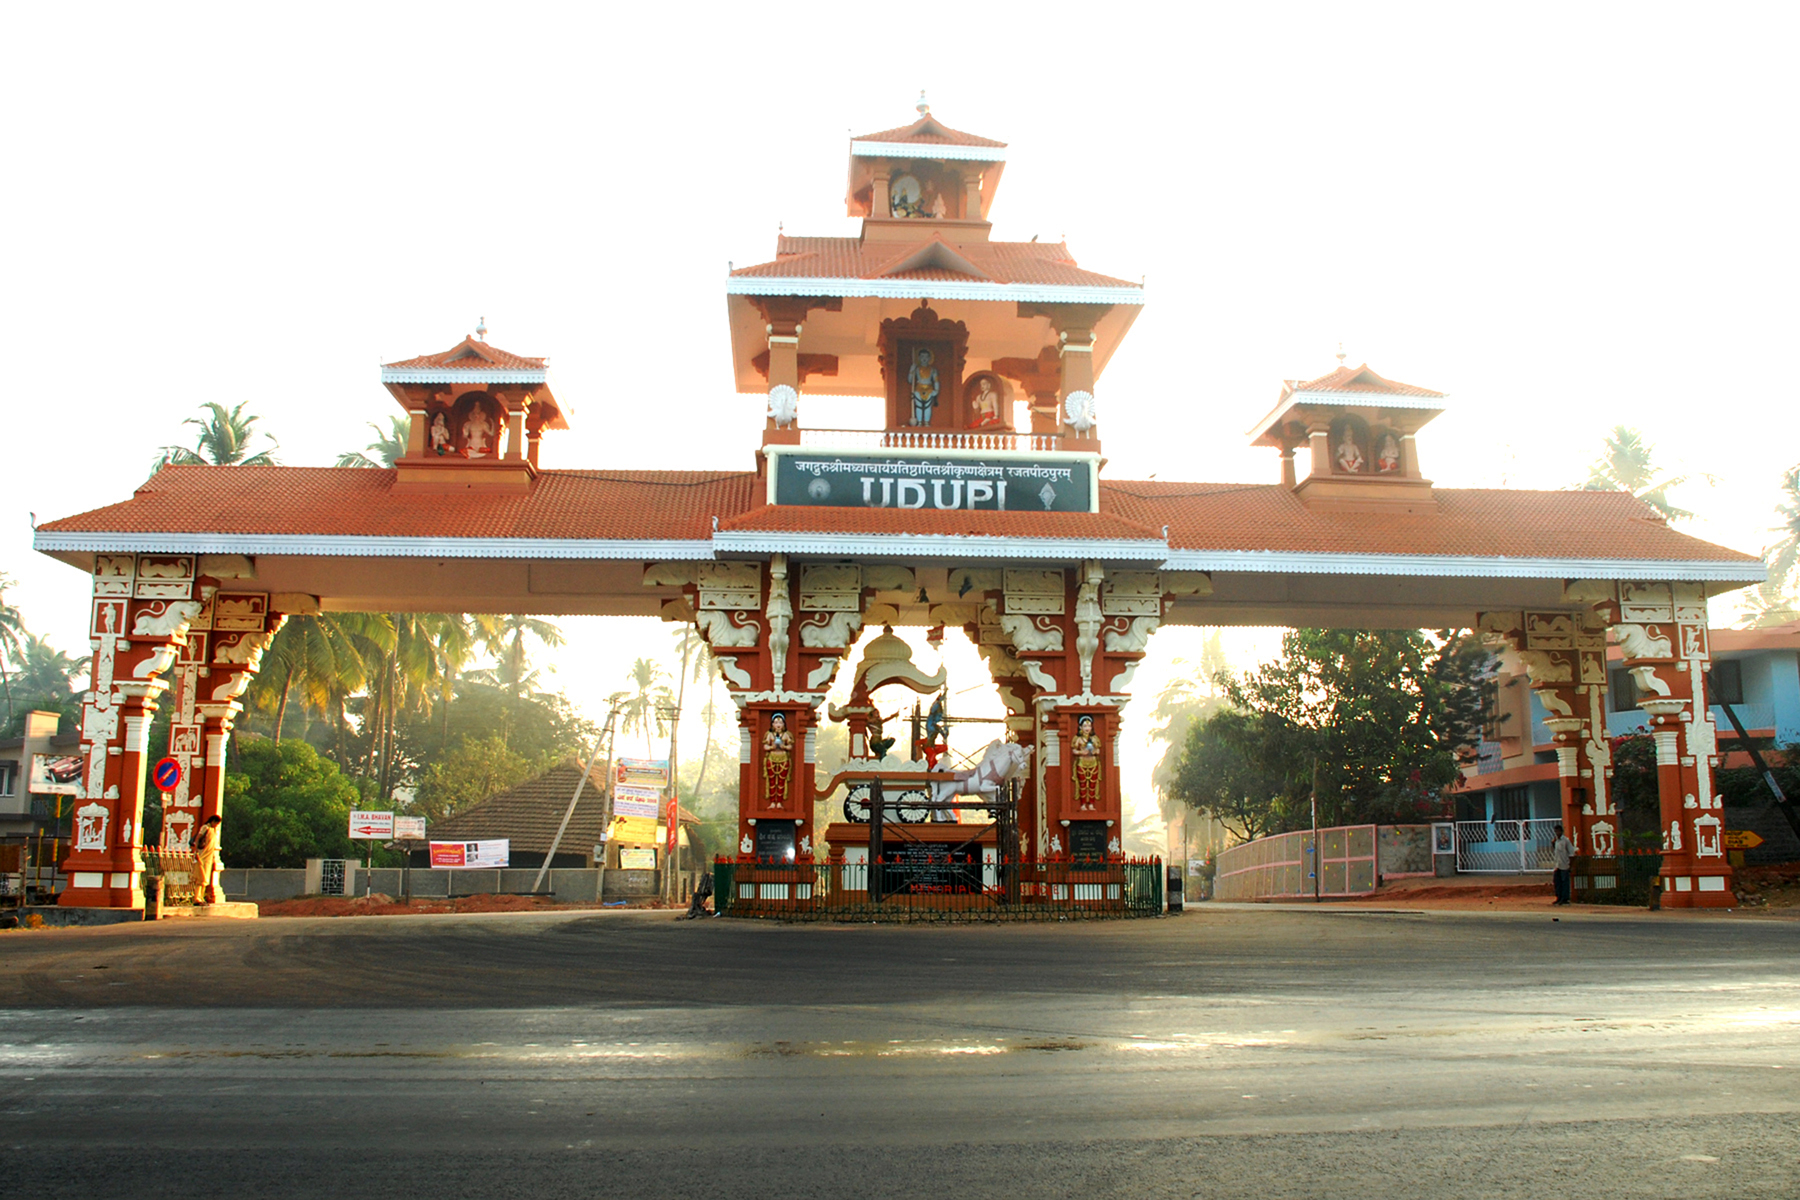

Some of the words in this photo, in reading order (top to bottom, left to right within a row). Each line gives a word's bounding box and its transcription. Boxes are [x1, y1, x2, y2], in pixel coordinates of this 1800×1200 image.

[1006, 464, 1073, 483] रजतपीठपुरम्
[860, 476, 1008, 511] UDUPI
[910, 883, 976, 895] MEMORIAL
[982, 884, 1006, 895] LION
[1020, 884, 1060, 895] CIRCLE
